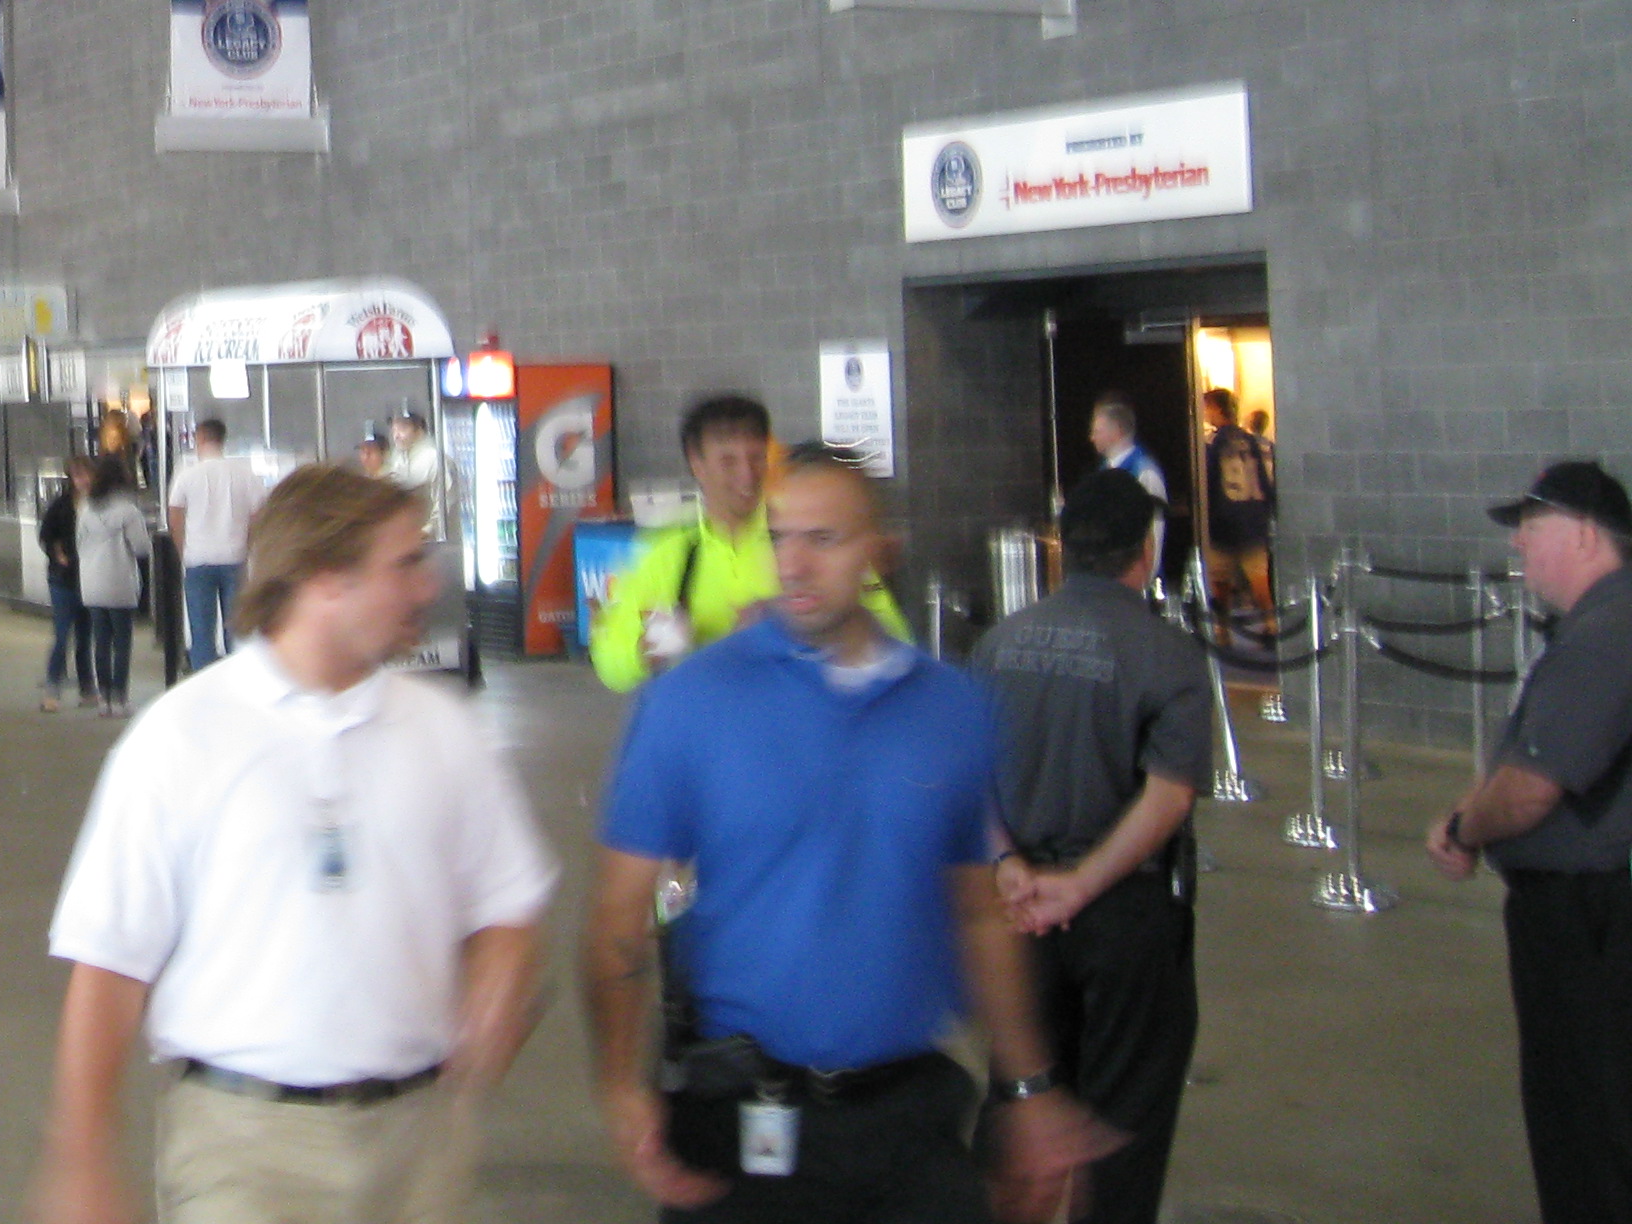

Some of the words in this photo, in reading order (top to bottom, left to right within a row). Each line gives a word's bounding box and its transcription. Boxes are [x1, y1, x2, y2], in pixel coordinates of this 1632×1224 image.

[1014, 178, 1052, 204] New
[217, 338, 260, 361] CREAM
[535, 404, 597, 491] G
